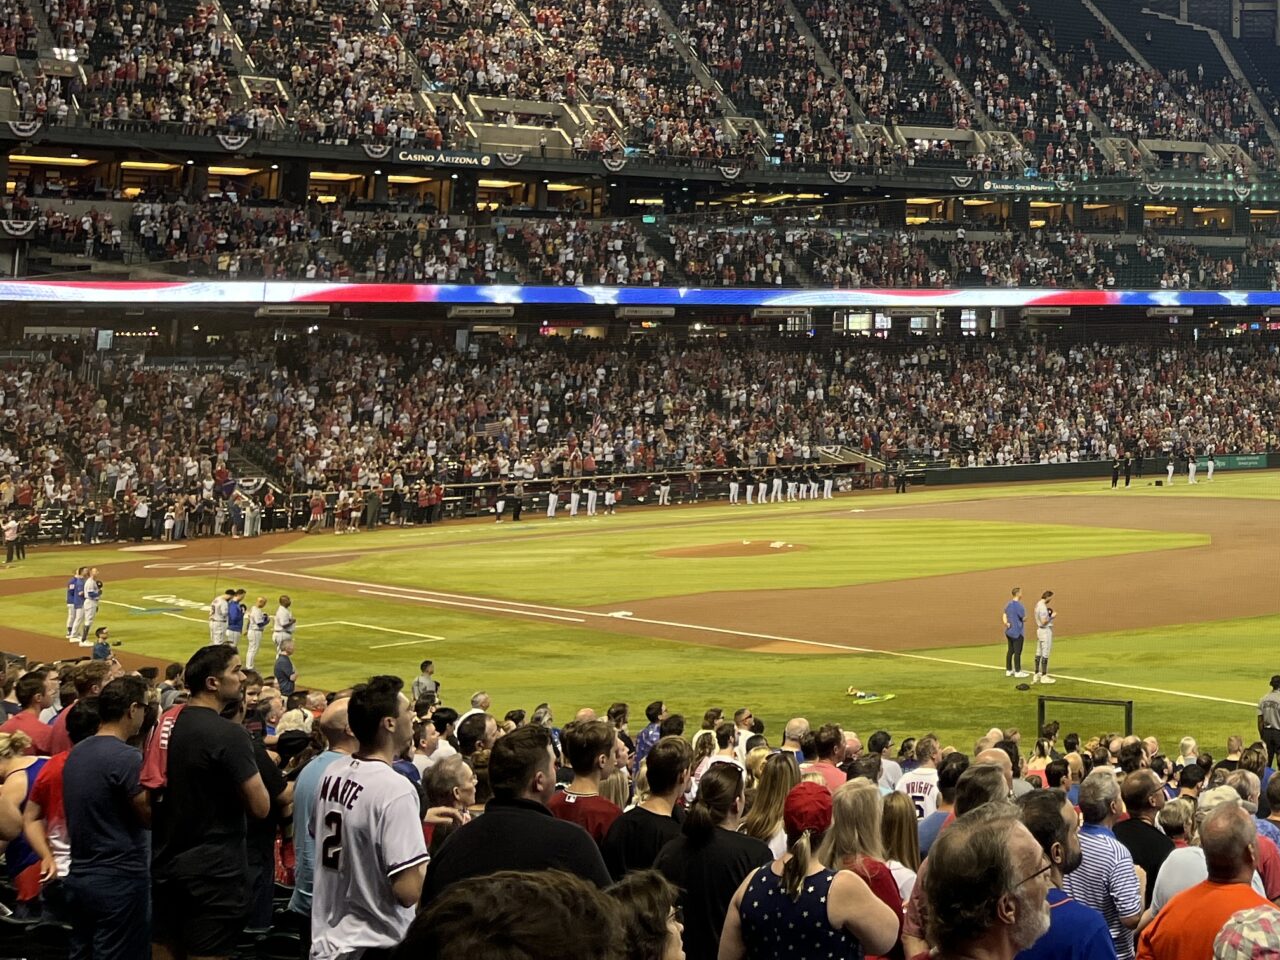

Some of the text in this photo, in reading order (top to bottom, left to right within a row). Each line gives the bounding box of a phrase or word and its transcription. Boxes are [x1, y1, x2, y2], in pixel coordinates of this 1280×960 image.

[398, 151, 479, 165] CASINO ARIZONA
[319, 775, 364, 810] MARTE
[906, 781, 933, 796] WRIGHT
[322, 811, 344, 873] 2
